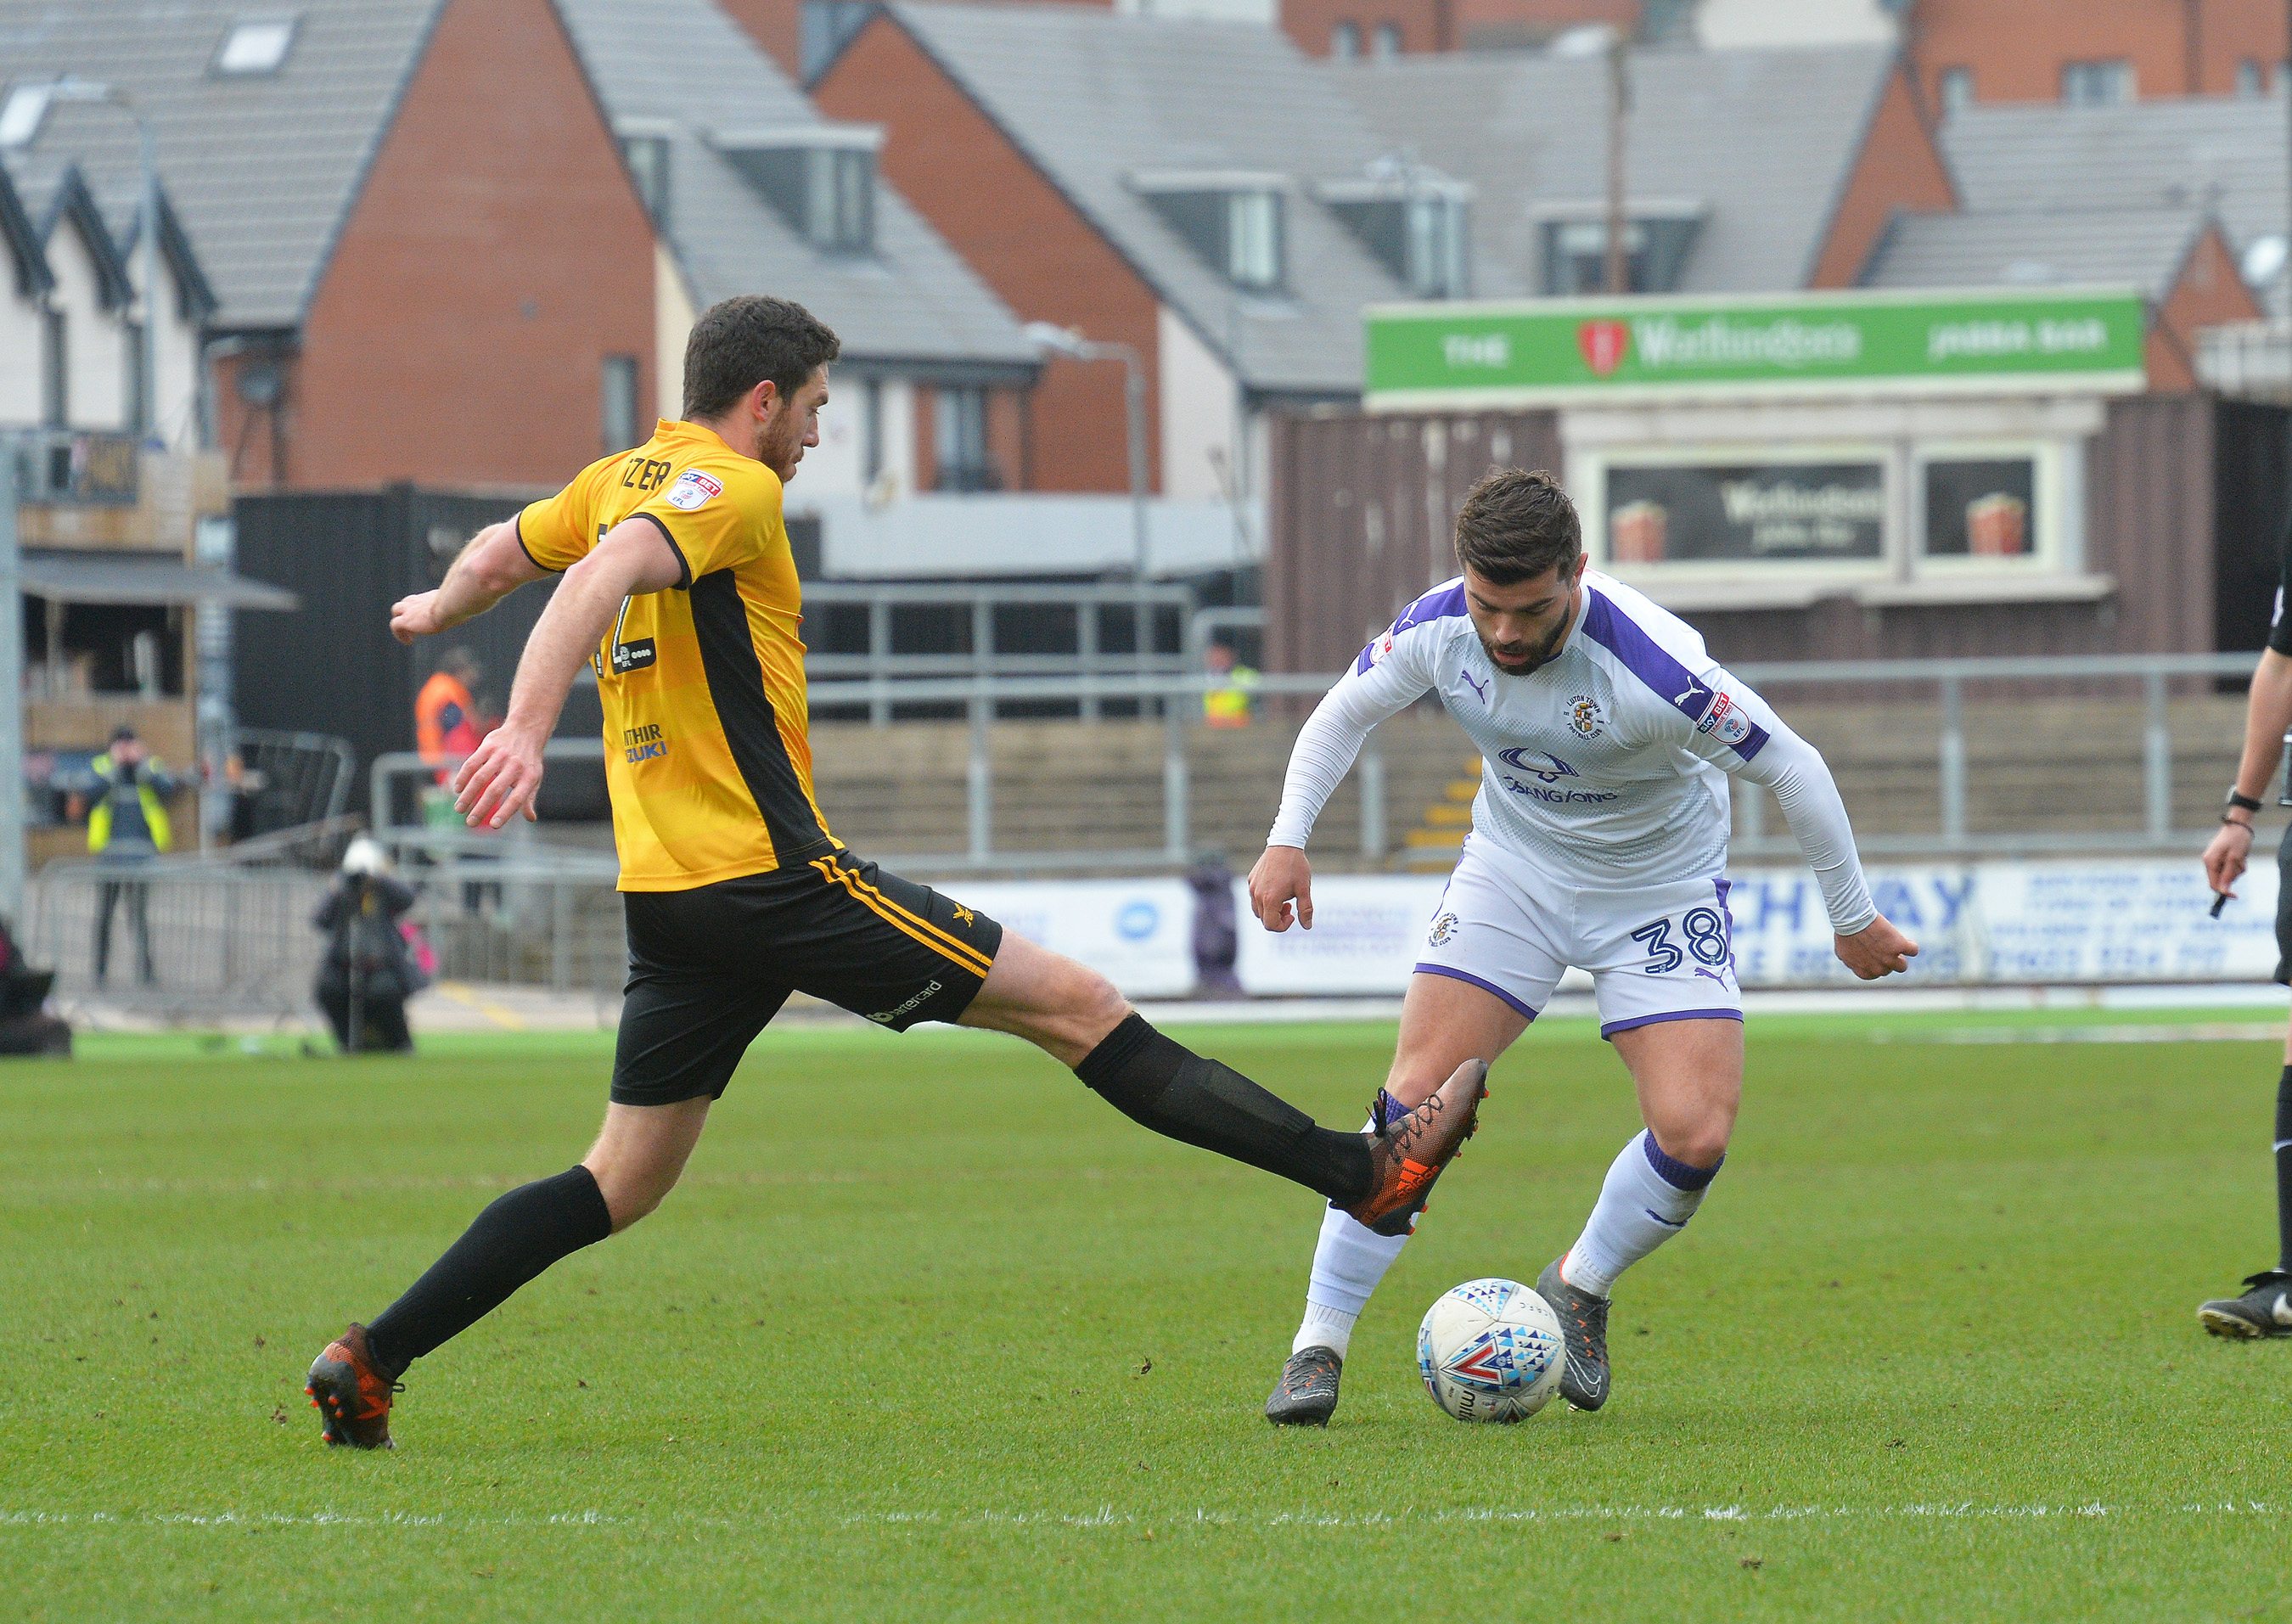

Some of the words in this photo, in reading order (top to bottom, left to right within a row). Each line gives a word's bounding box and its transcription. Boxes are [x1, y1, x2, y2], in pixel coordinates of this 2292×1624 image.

[1444, 335, 1508, 366] THE
[699, 478, 718, 492] BET
[672, 496, 683, 505] EFL
[1566, 695, 1585, 707] LUTON
[1586, 696, 1602, 714] TOWN
[1699, 716, 1716, 733] sky
[1715, 694, 1728, 715] BET
[1710, 715, 1727, 733] LEAGUE
[1724, 704, 1733, 716] TWO
[1567, 722, 1591, 741] FOOTBALL
[1590, 728, 1603, 739] CLUB
[1733, 727, 1745, 738] EFL
[1439, 936, 1452, 946] CLUB
[1631, 907, 1728, 974] 38
